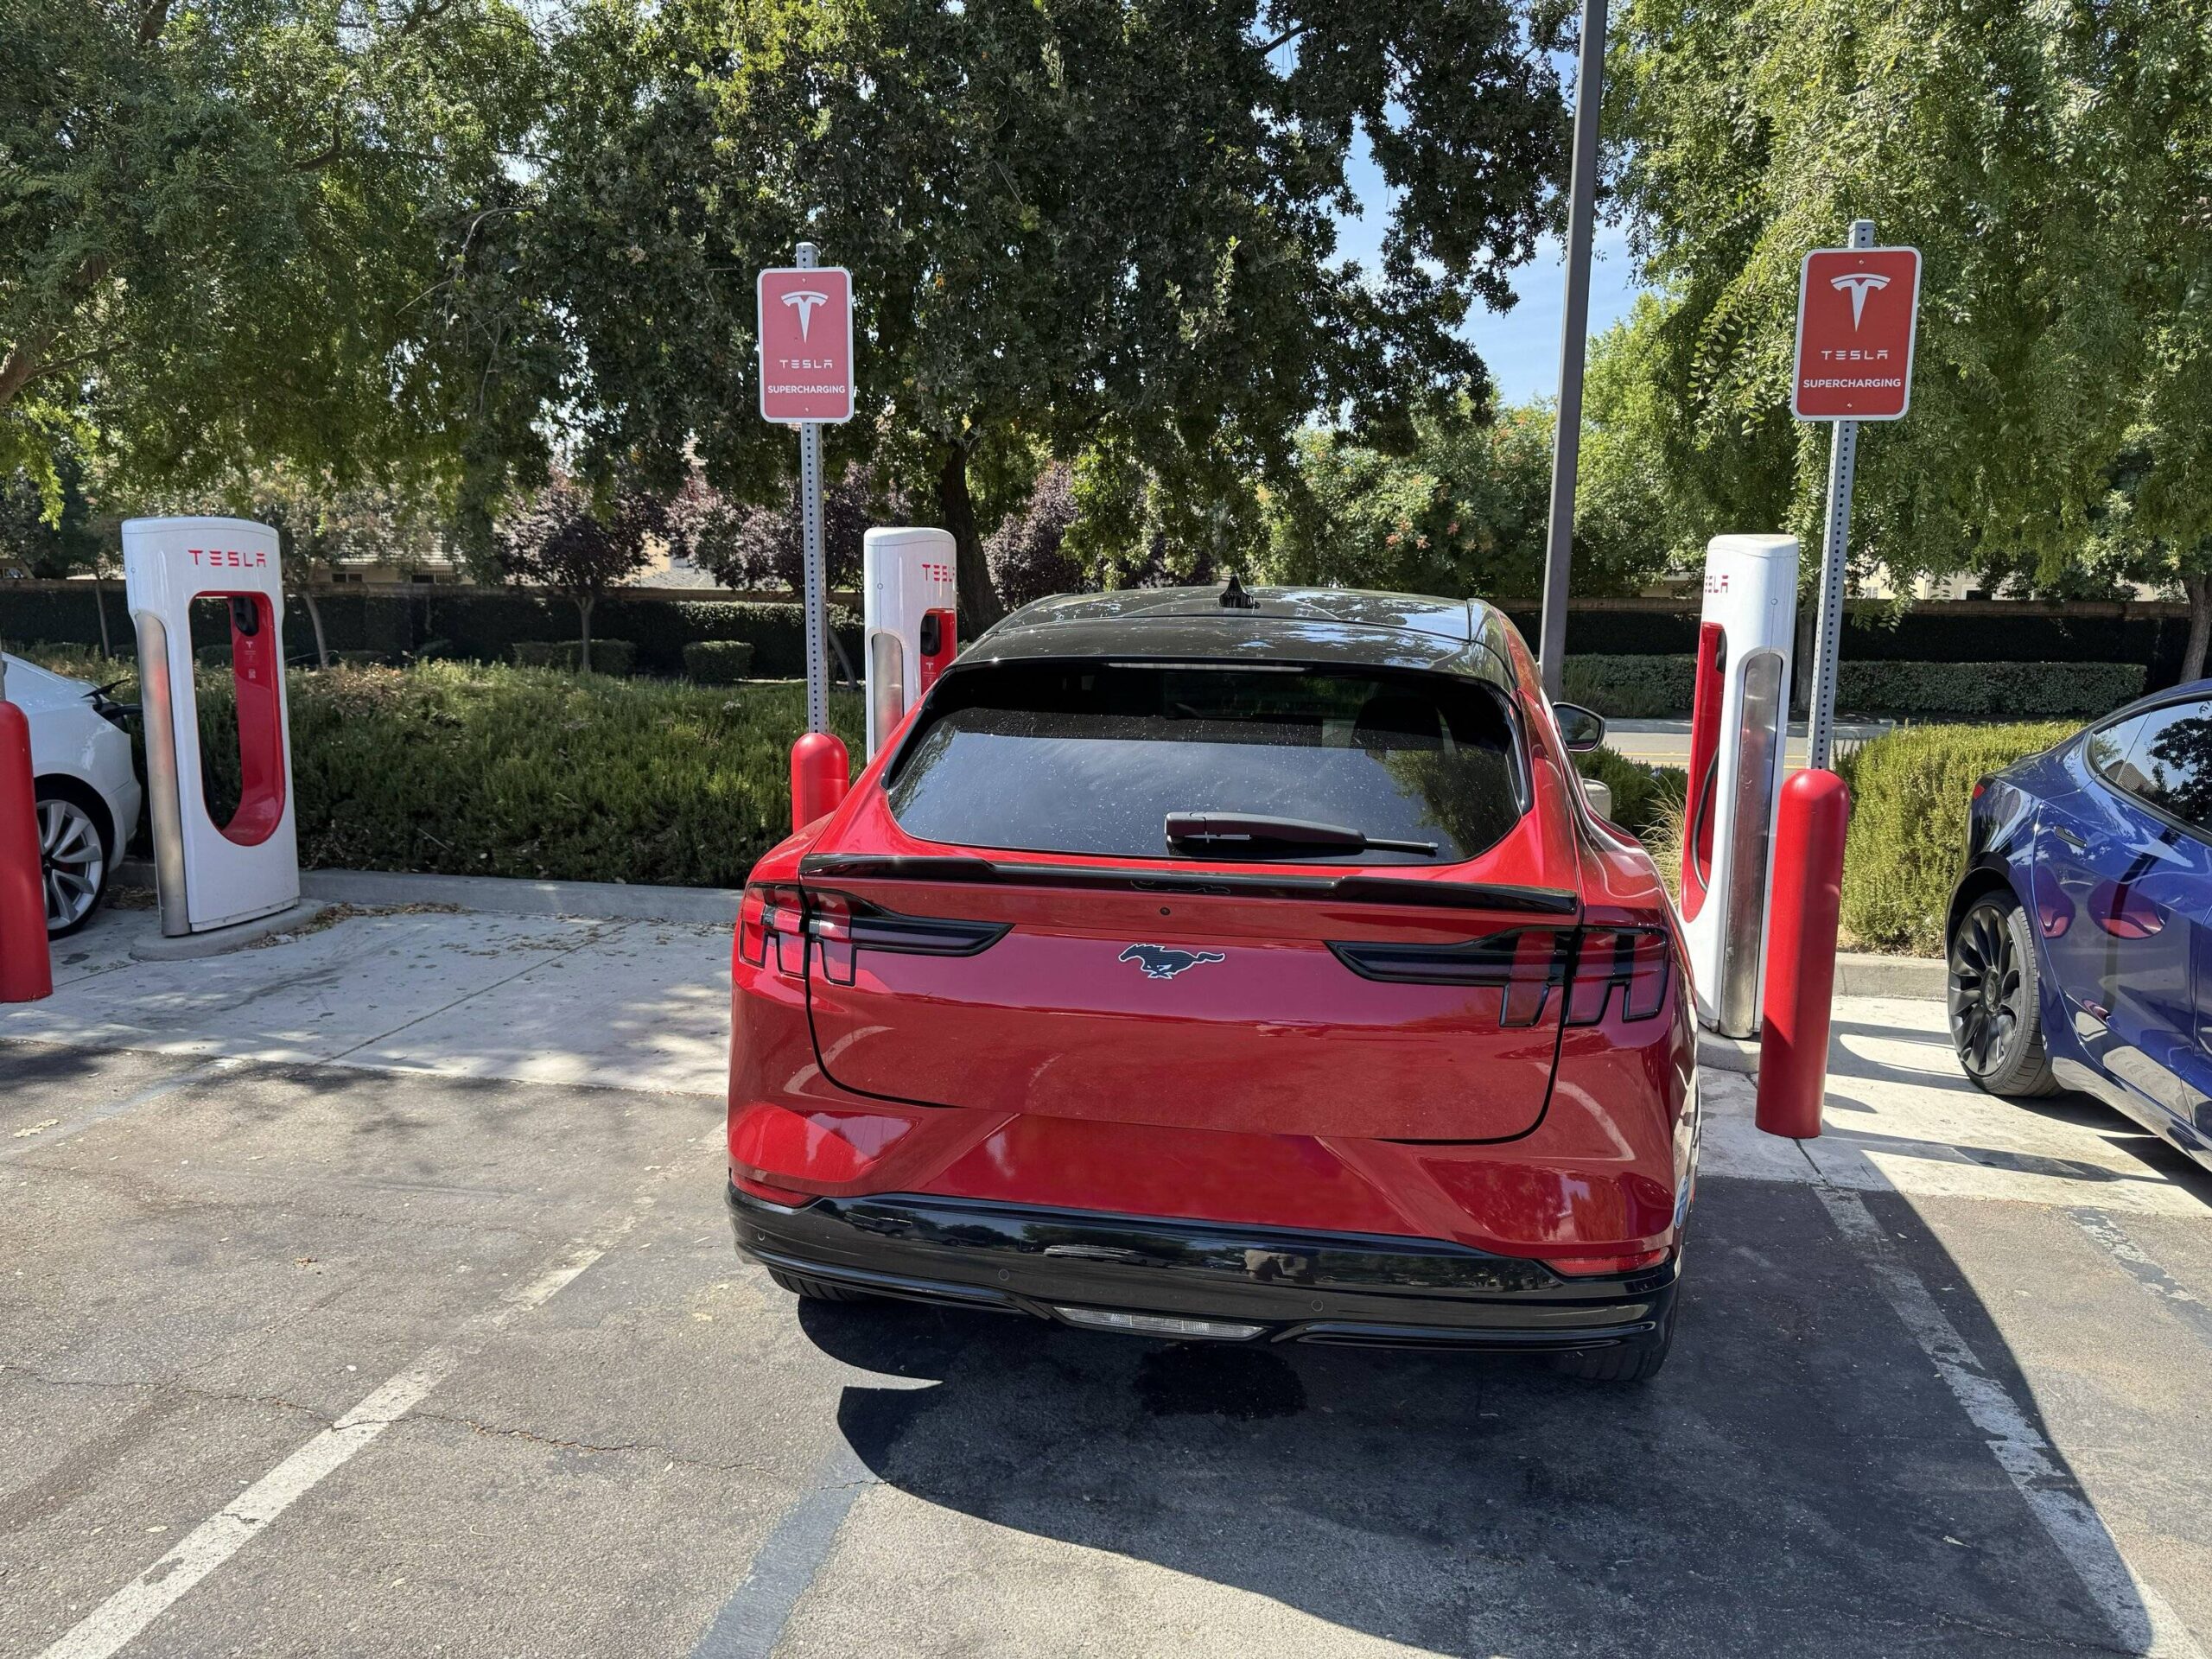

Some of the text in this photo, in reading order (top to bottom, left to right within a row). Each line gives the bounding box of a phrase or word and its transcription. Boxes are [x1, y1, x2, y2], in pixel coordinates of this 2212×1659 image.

[1821, 350, 1889, 360] TESLA
[779, 359, 833, 369] TESLA
[1802, 378, 1902, 388] SUPERCHARGING
[767, 385, 846, 394] SUPERCHARGING
[188, 550, 267, 568] TESLA
